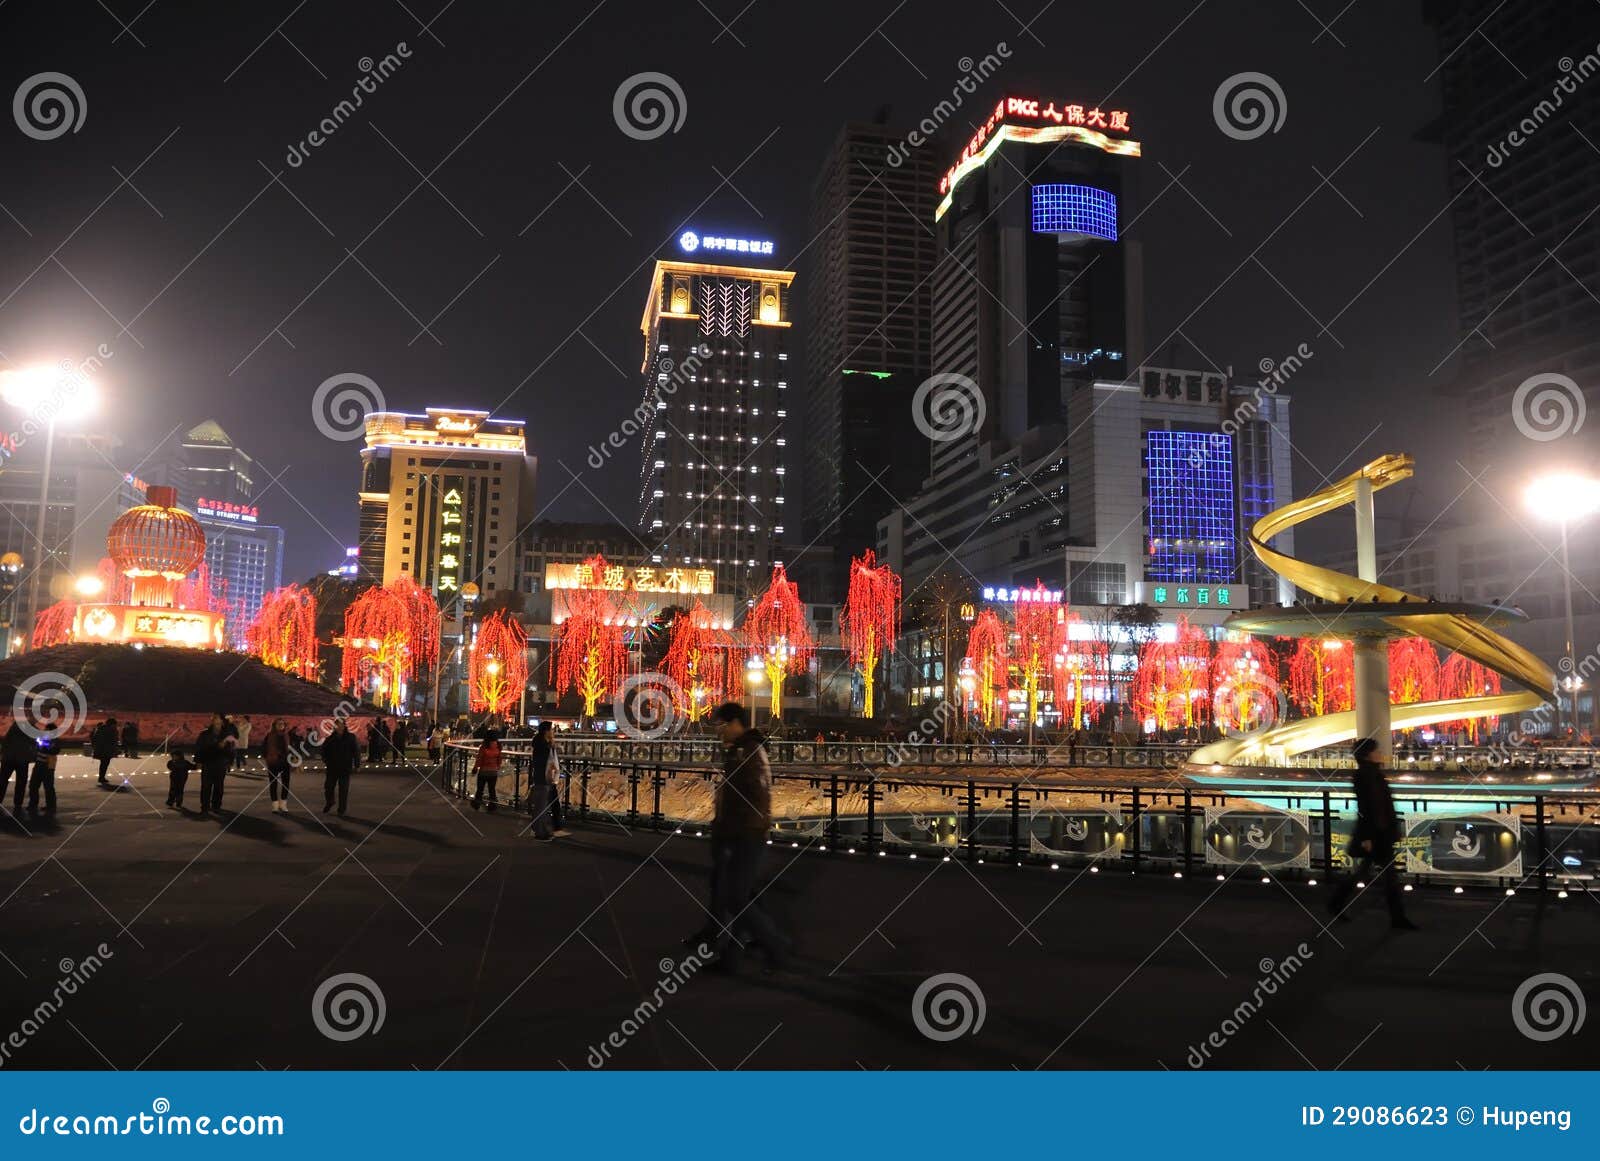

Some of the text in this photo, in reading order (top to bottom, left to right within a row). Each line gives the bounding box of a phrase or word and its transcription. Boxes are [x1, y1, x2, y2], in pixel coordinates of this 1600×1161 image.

[1008, 97, 1130, 132] PICC 人保大厦
[439, 511, 461, 591] 仁和春天
[575, 564, 715, 593] 锦城艺术宫
[1154, 587, 1230, 605] 摩尔百货
